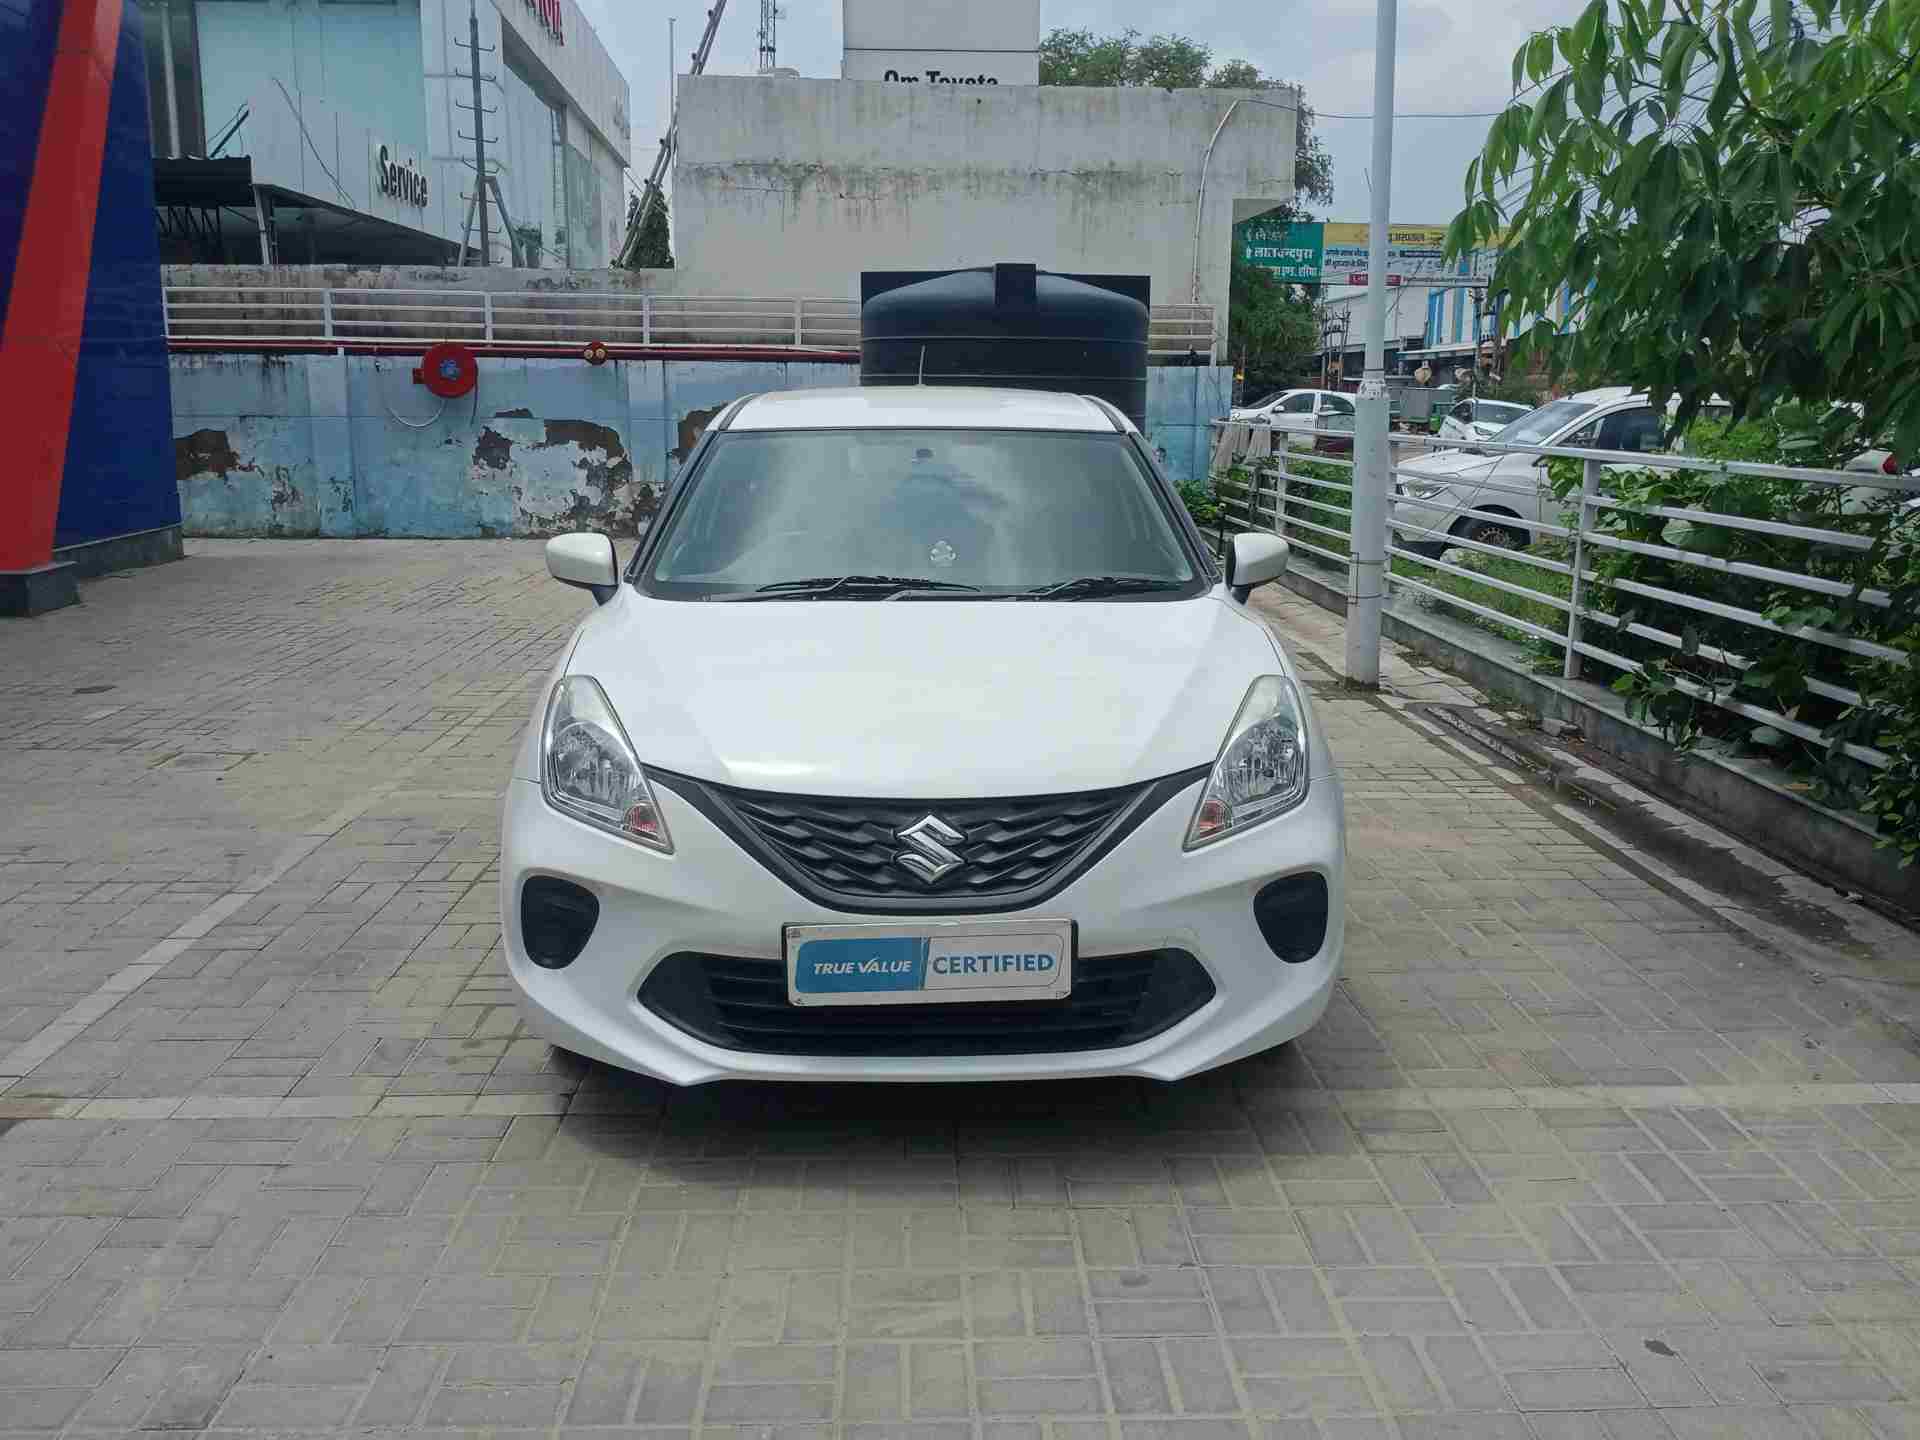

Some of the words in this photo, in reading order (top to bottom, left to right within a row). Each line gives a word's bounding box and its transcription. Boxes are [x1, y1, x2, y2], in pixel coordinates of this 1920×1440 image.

[884, 70, 919, 83] Om
[380, 145, 427, 207] Service
[813, 961, 854, 975] TRUE
[858, 957, 912, 974] VALUE
[932, 954, 1054, 975] CERTIFIED
